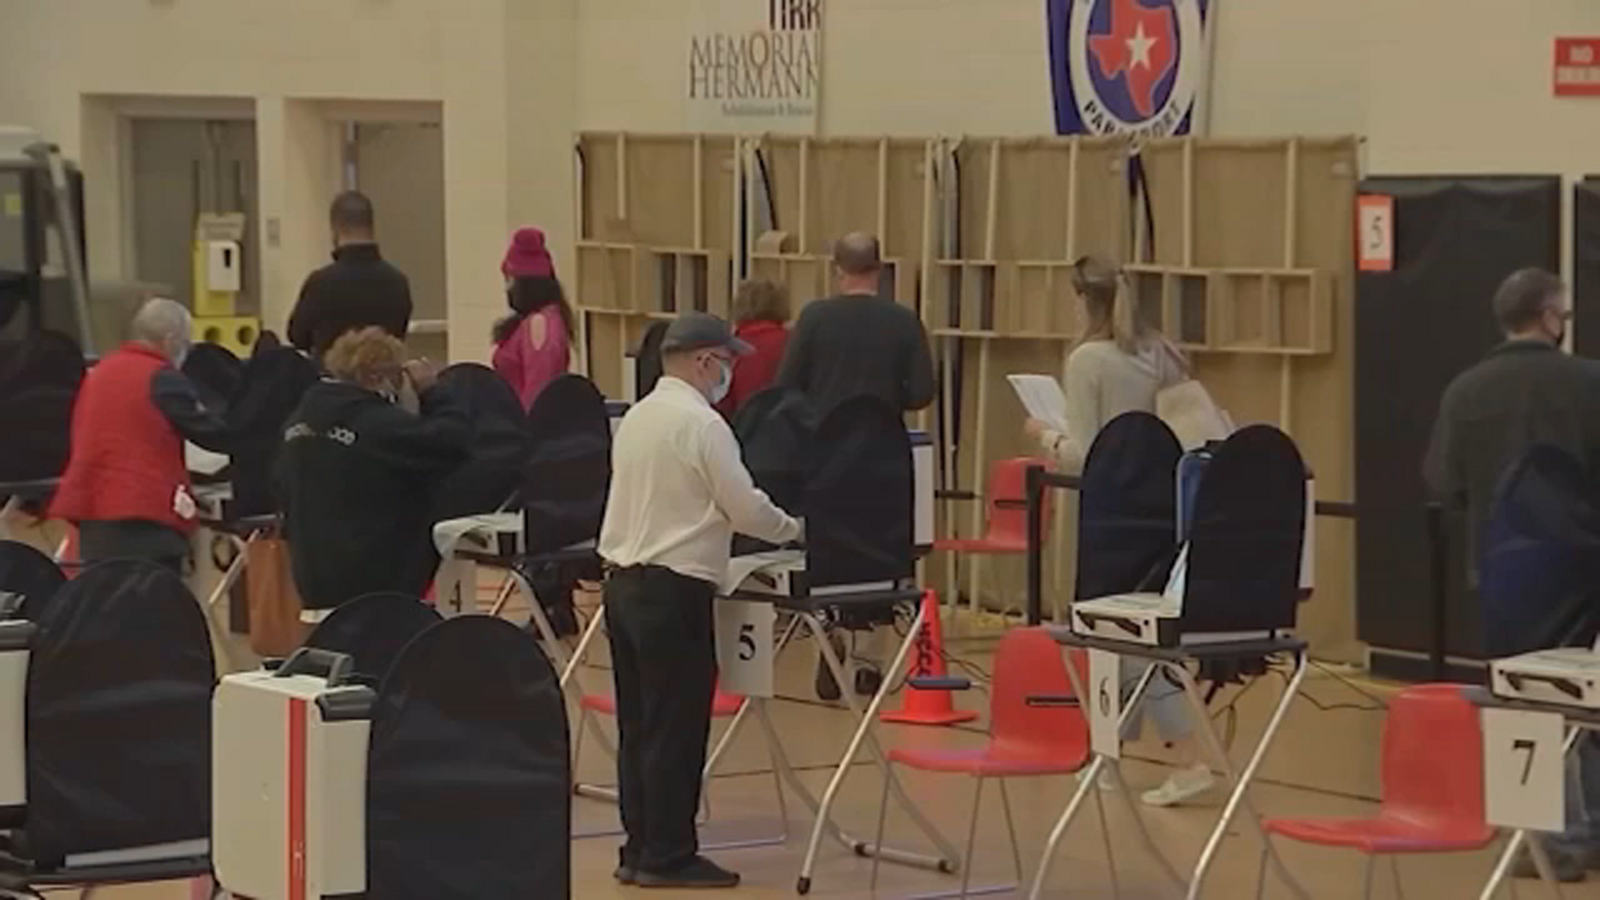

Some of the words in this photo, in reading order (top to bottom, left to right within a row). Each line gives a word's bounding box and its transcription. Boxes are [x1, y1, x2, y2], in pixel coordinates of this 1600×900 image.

[690, 31, 818, 68] MEMORIAL
[1084, 99, 1181, 149] PARPORT
[1370, 215, 1383, 249] 5
[448, 580, 461, 612] 4
[739, 624, 755, 660] 5
[1100, 676, 1111, 718] 6
[1512, 740, 1536, 785] 7
